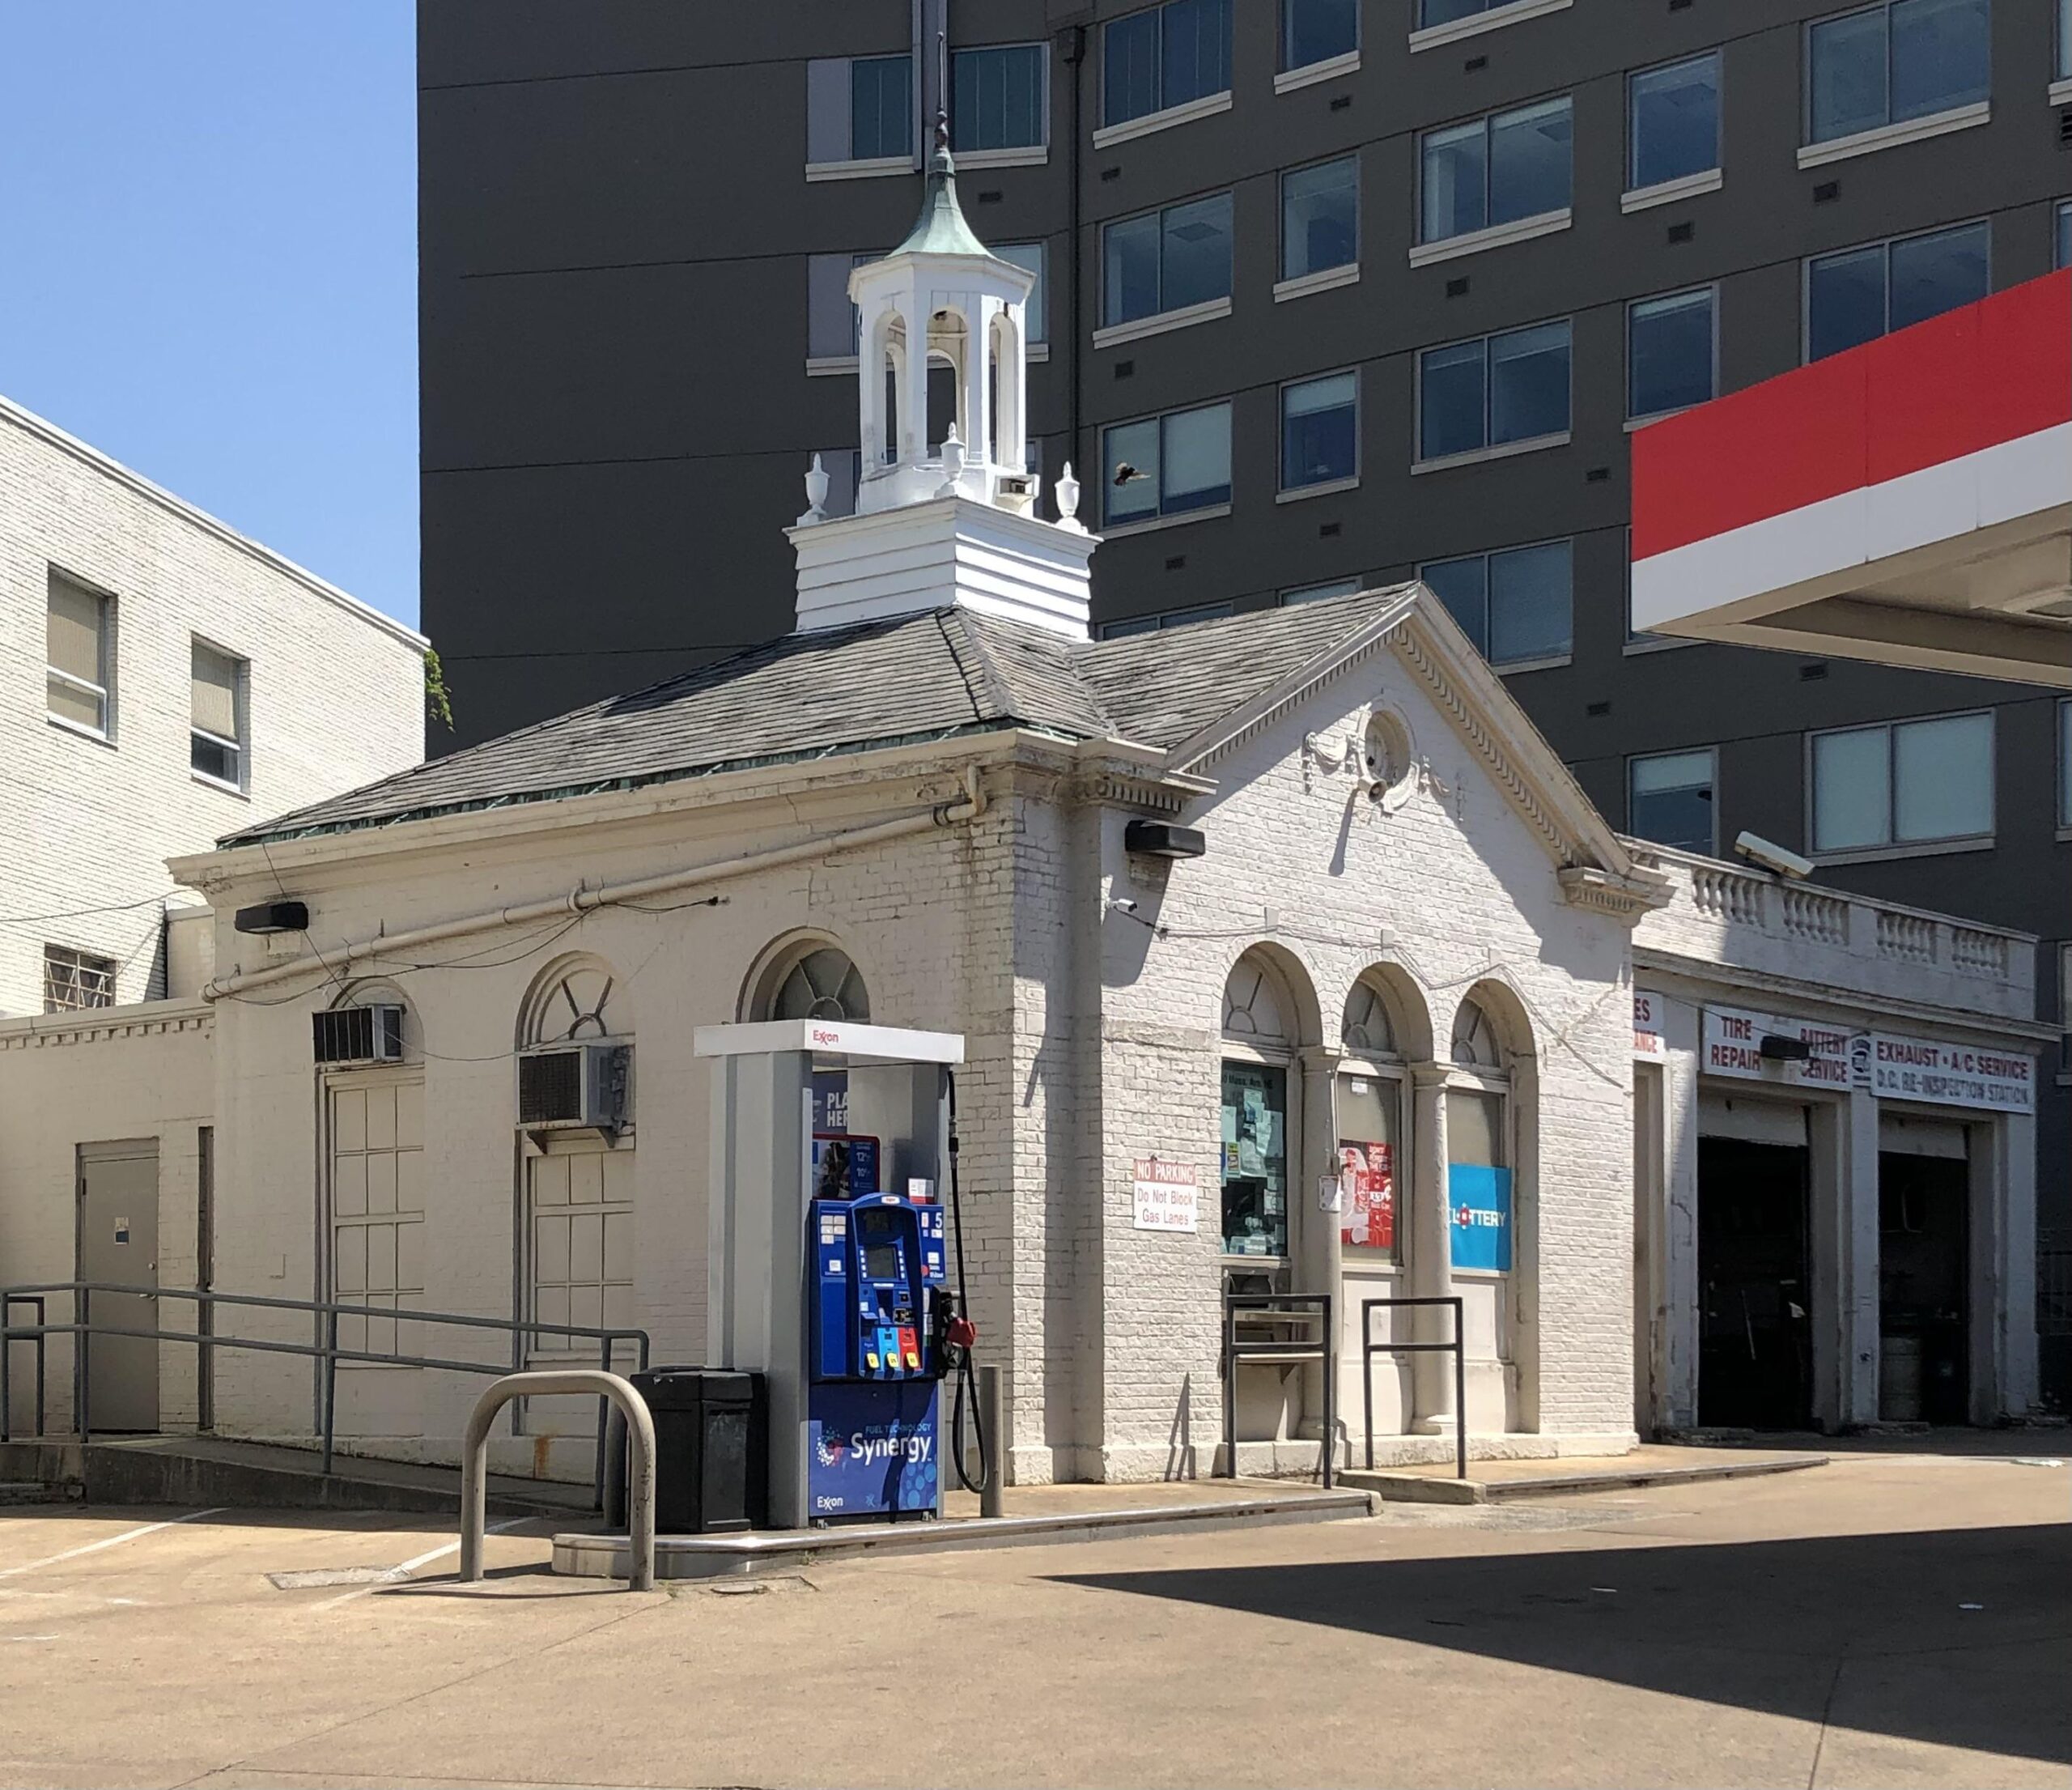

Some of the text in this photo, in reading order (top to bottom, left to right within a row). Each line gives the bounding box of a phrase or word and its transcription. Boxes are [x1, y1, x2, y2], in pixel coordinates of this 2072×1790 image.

[813, 1030, 839, 1045] Exxon
[1721, 1016, 1752, 1040] TIRE
[1711, 1044, 1761, 1071] REPAIR
[1877, 1040, 1938, 1068] EXHAUST
[1976, 1055, 2028, 1081] SERVICE
[1801, 1057, 1848, 1083] SERVICE
[1136, 1161, 1193, 1184] NO PARKING
[1137, 1188, 1193, 1205] Do Not Block
[935, 1211, 943, 1228] 5
[1143, 1208, 1189, 1225] Gas Lanes
[851, 1432, 932, 1466] Synergy
[817, 1495, 843, 1511] Exxon
